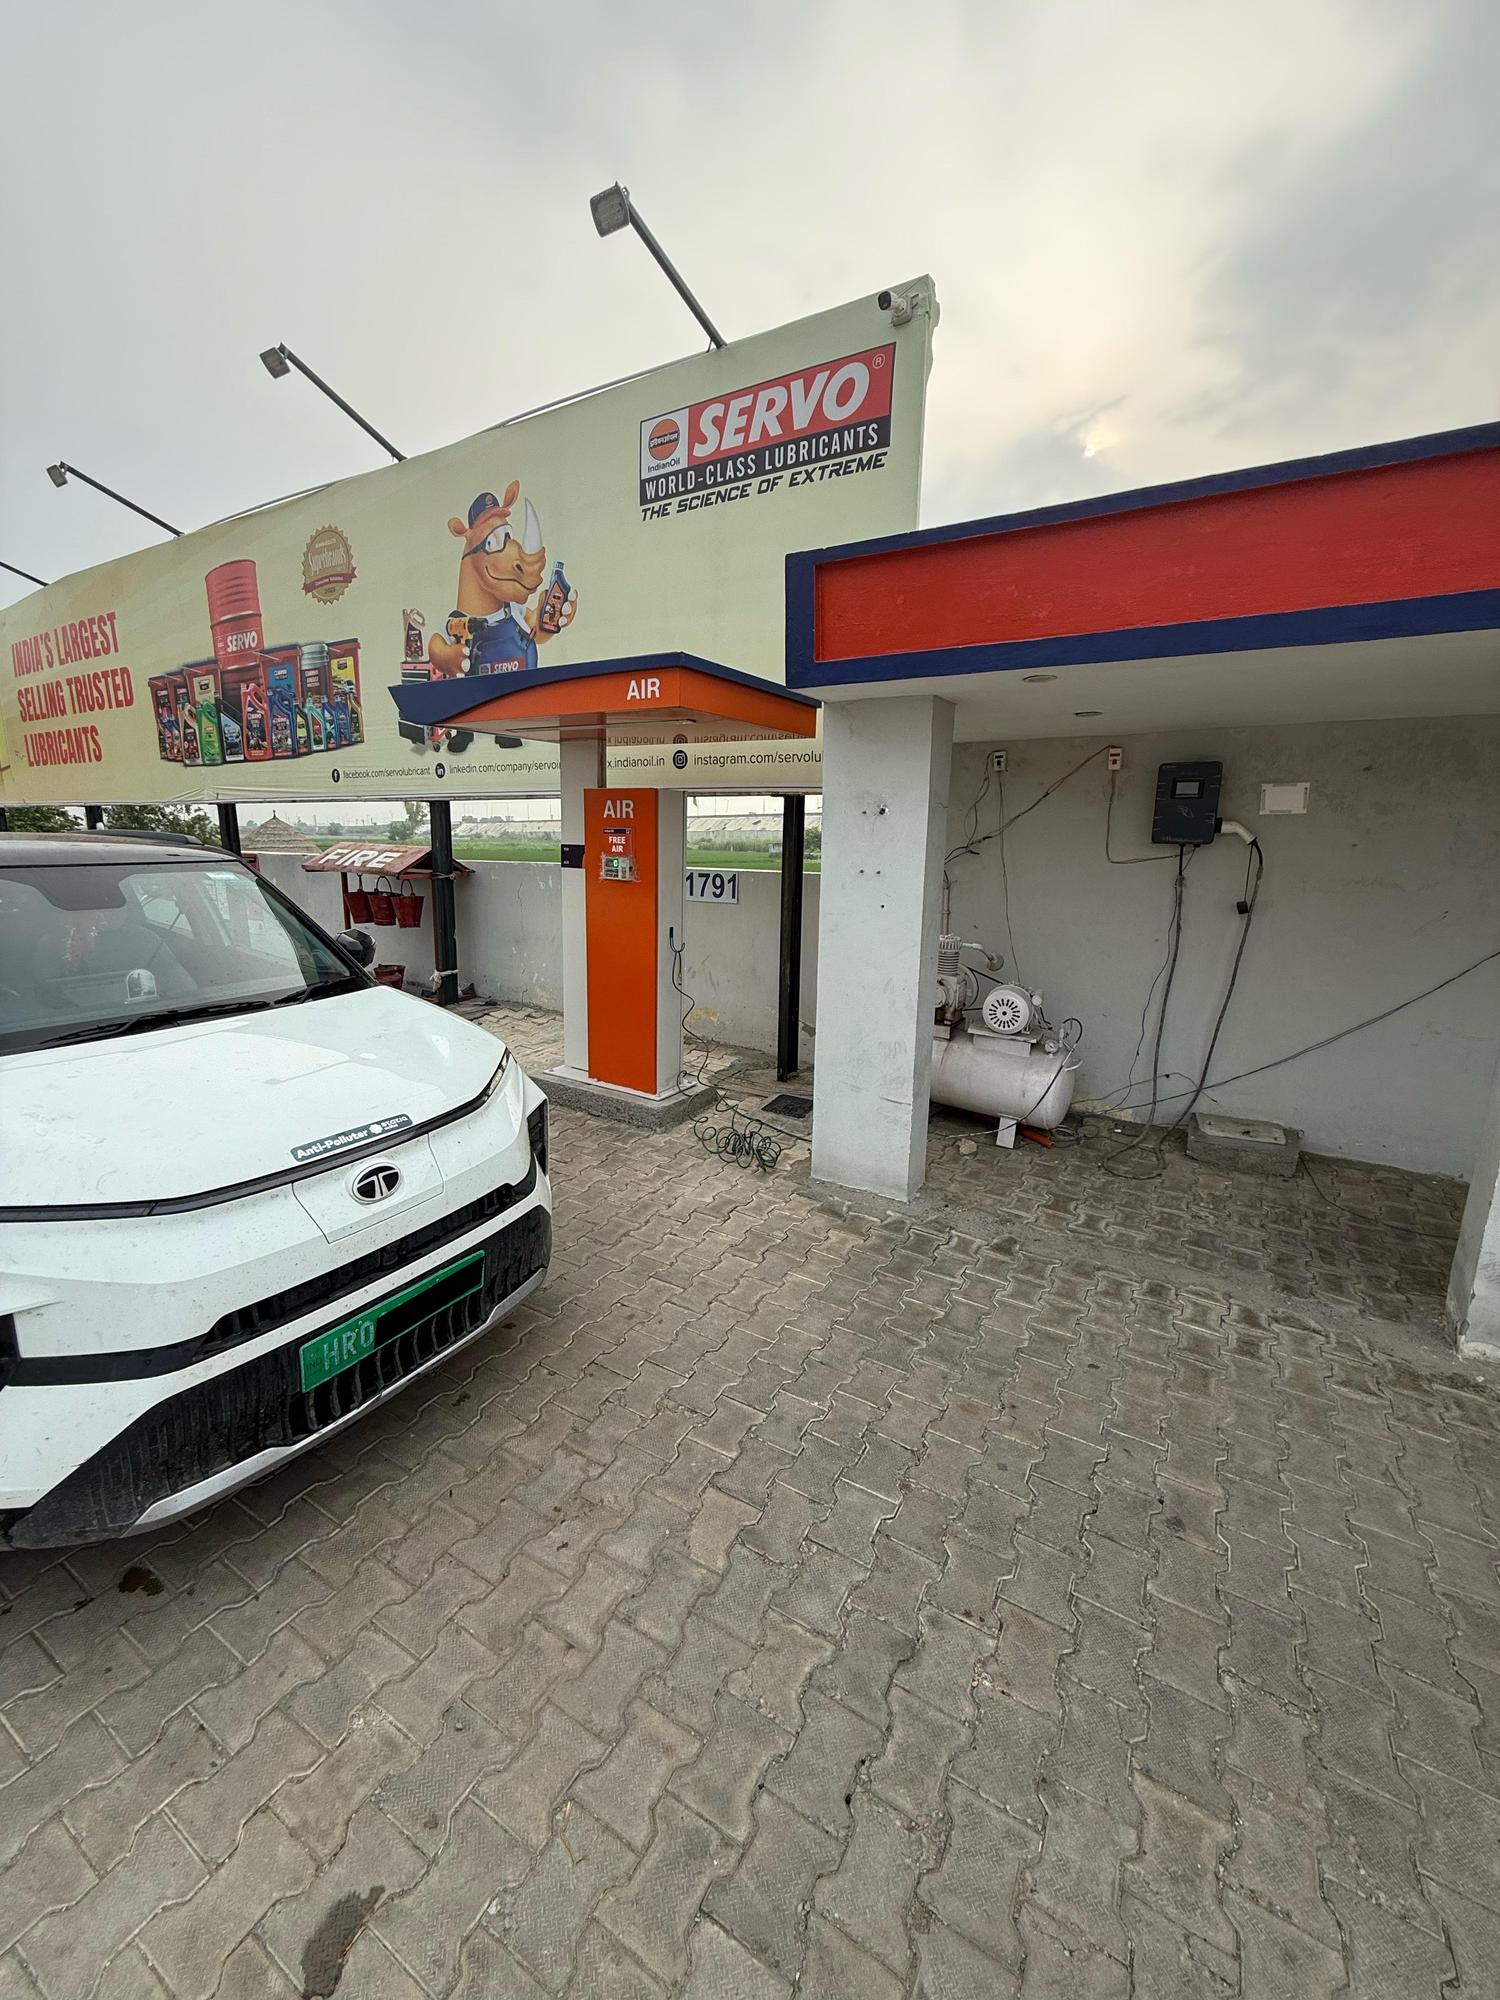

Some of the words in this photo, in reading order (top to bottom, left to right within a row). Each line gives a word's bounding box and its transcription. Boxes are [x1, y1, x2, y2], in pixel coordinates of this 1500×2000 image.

[693, 362, 870, 457] SERVO
[645, 454, 756, 501] WORLD-CLASS
[764, 423, 879, 471] LUBRICANTS
[647, 457, 681, 474] IndianOil
[641, 502, 672, 522] THE
[676, 483, 752, 513] SCIENCE
[757, 475, 783, 495] OF
[788, 451, 888, 488] EXTREME
[12, 631, 54, 677] INDIA'S
[54, 611, 119, 666] LARGEST
[227, 631, 258, 653] SERVO
[494, 660, 519, 673] SERVO
[17, 680, 67, 723] SELLING
[66, 666, 134, 715] TRUSTED
[627, 677, 661, 700] AIR
[24, 725, 103, 767] LUBRICANTS
[693, 750, 823, 768] instagram.com/servolu
[343, 767, 431, 779] facebook.com/servolubricant
[603, 799, 634, 819] AIR
[608, 836, 626, 845] FREE
[611, 845, 624, 853] AIR
[318, 848, 403, 869] FIRE
[685, 871, 738, 900] 1791
[296, 1129, 368, 1159] Anti-Polluter
